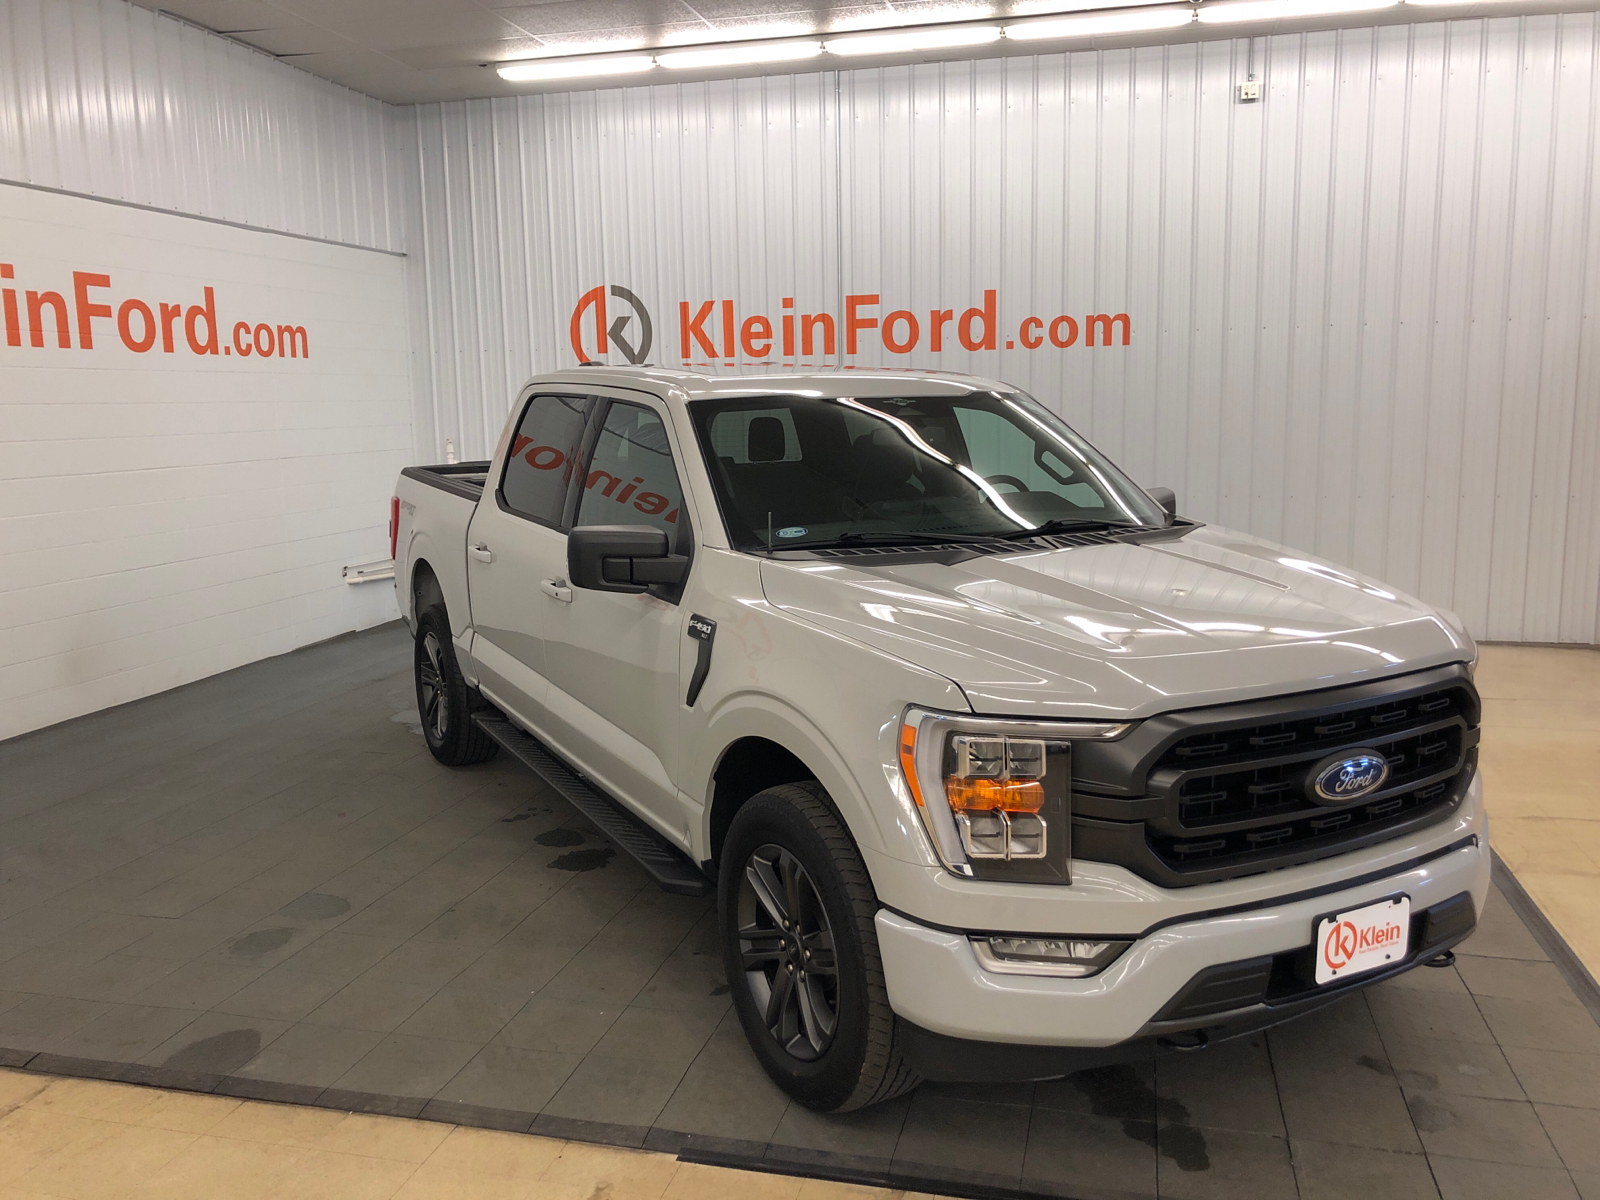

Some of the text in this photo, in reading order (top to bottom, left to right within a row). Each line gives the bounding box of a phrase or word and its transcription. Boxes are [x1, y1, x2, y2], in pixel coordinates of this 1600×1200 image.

[679, 289, 1130, 359] KleinFord.com
[1335, 766, 1374, 793] Ford
[1359, 922, 1401, 949] Klein
